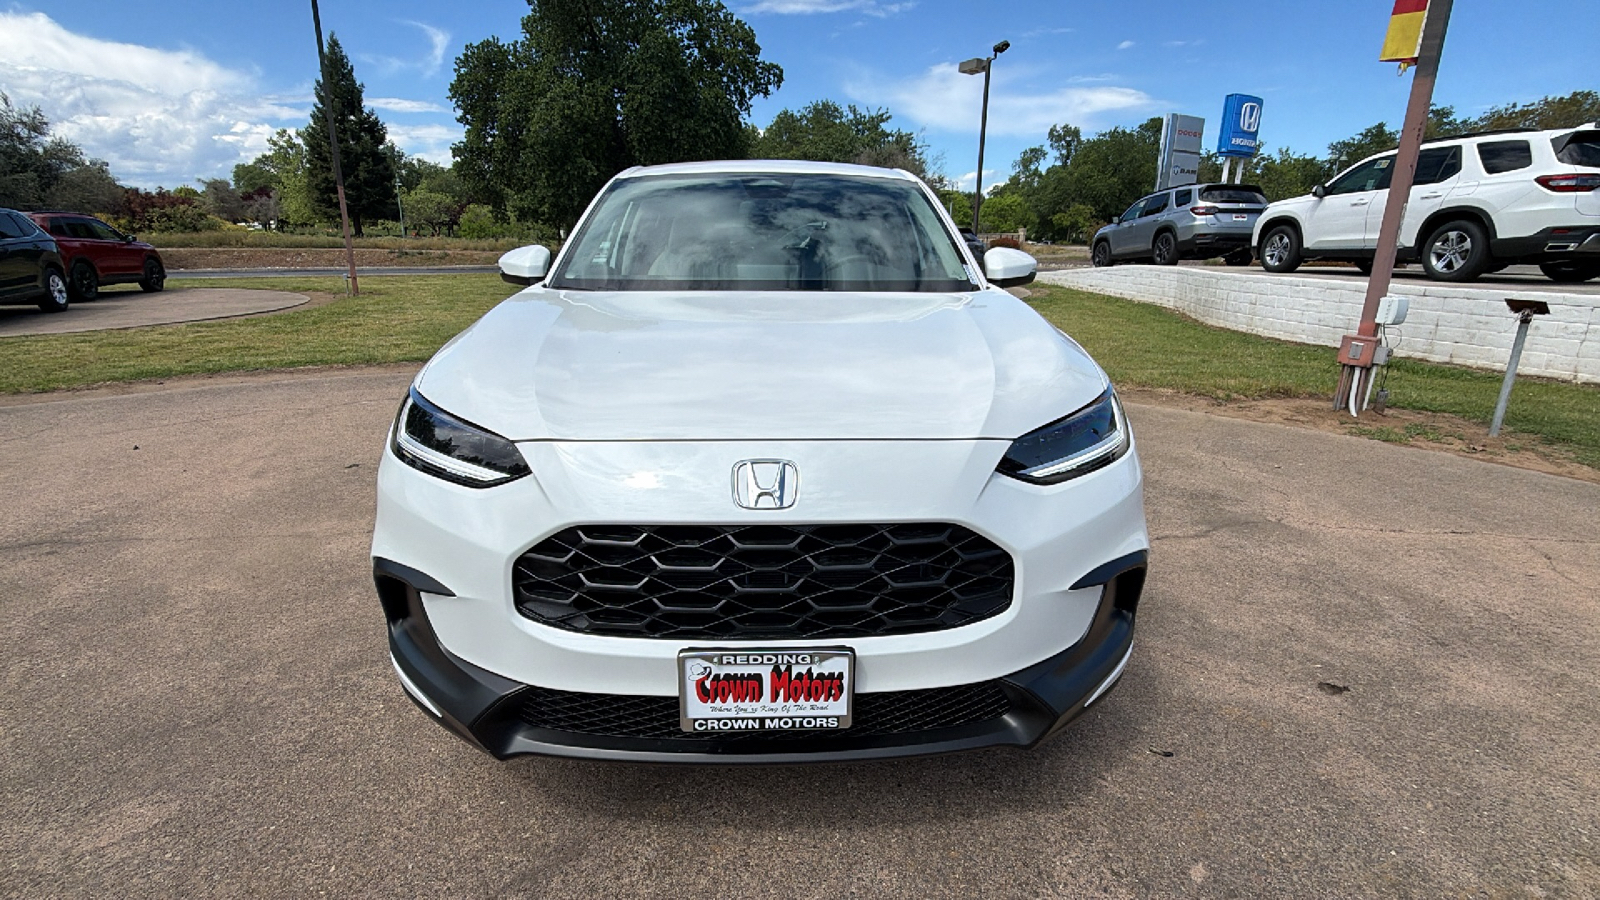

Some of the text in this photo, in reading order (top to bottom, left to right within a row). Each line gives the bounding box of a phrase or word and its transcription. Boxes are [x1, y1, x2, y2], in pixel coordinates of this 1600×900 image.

[722, 654, 811, 665] REDDING
[695, 665, 844, 703] Crown Motors
[760, 705, 779, 713] King
[694, 717, 839, 730] CROWN MOTORS
